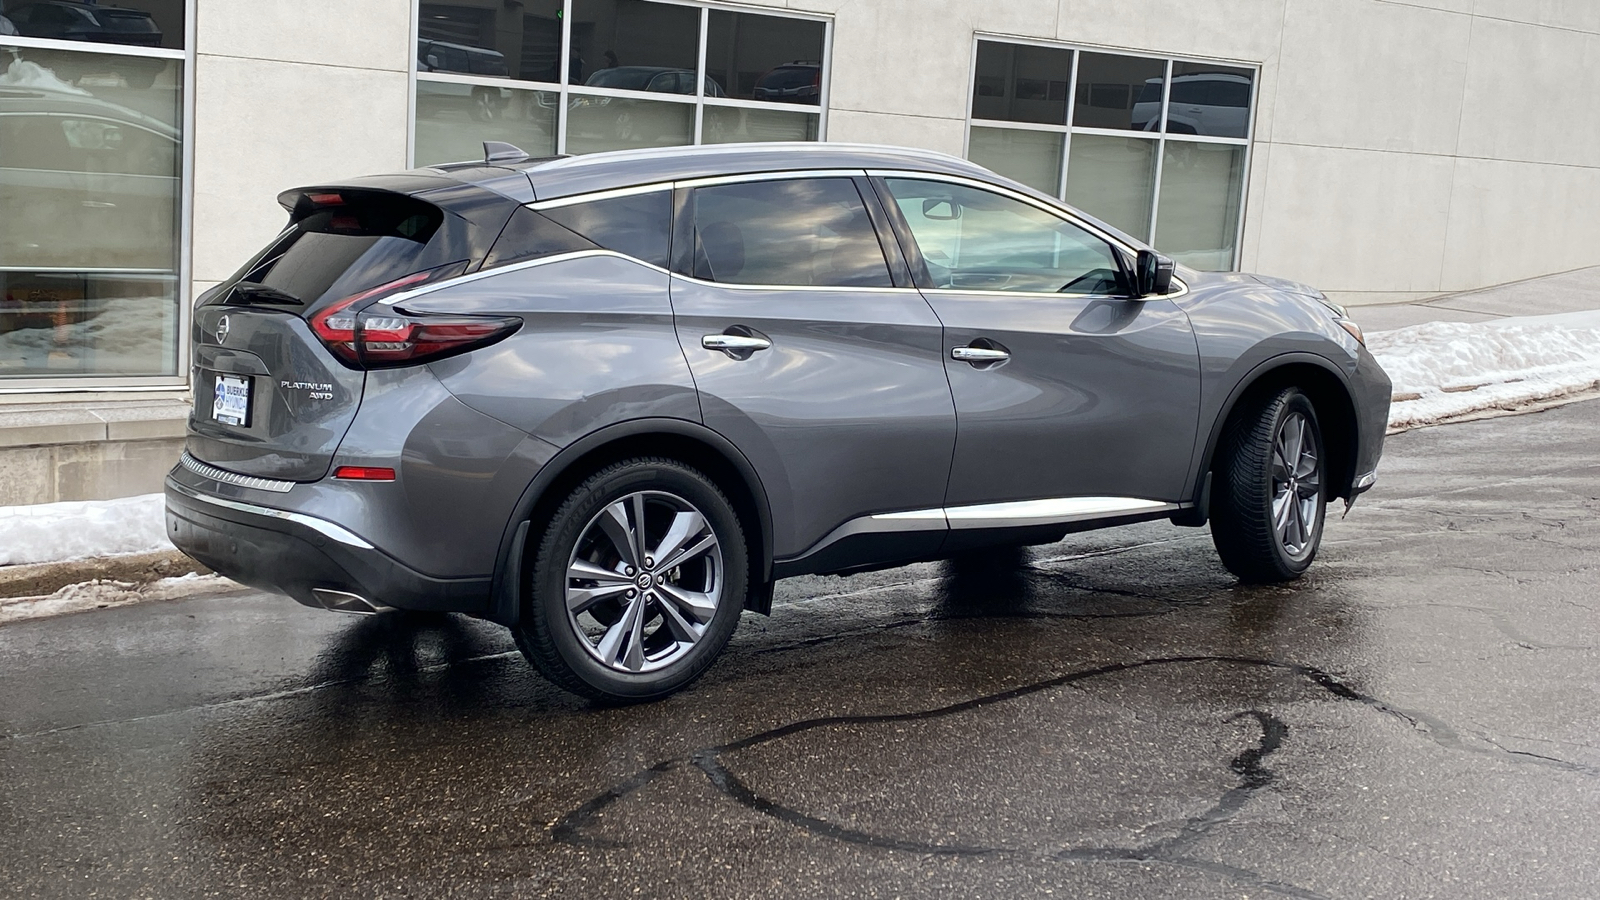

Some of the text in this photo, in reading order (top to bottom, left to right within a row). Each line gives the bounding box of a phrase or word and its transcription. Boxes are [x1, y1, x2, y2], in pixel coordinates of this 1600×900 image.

[226, 385, 249, 398] BUERKLE
[280, 380, 333, 391] PLATINUM
[308, 391, 334, 400] AWD
[225, 395, 247, 410] HYUNDA
